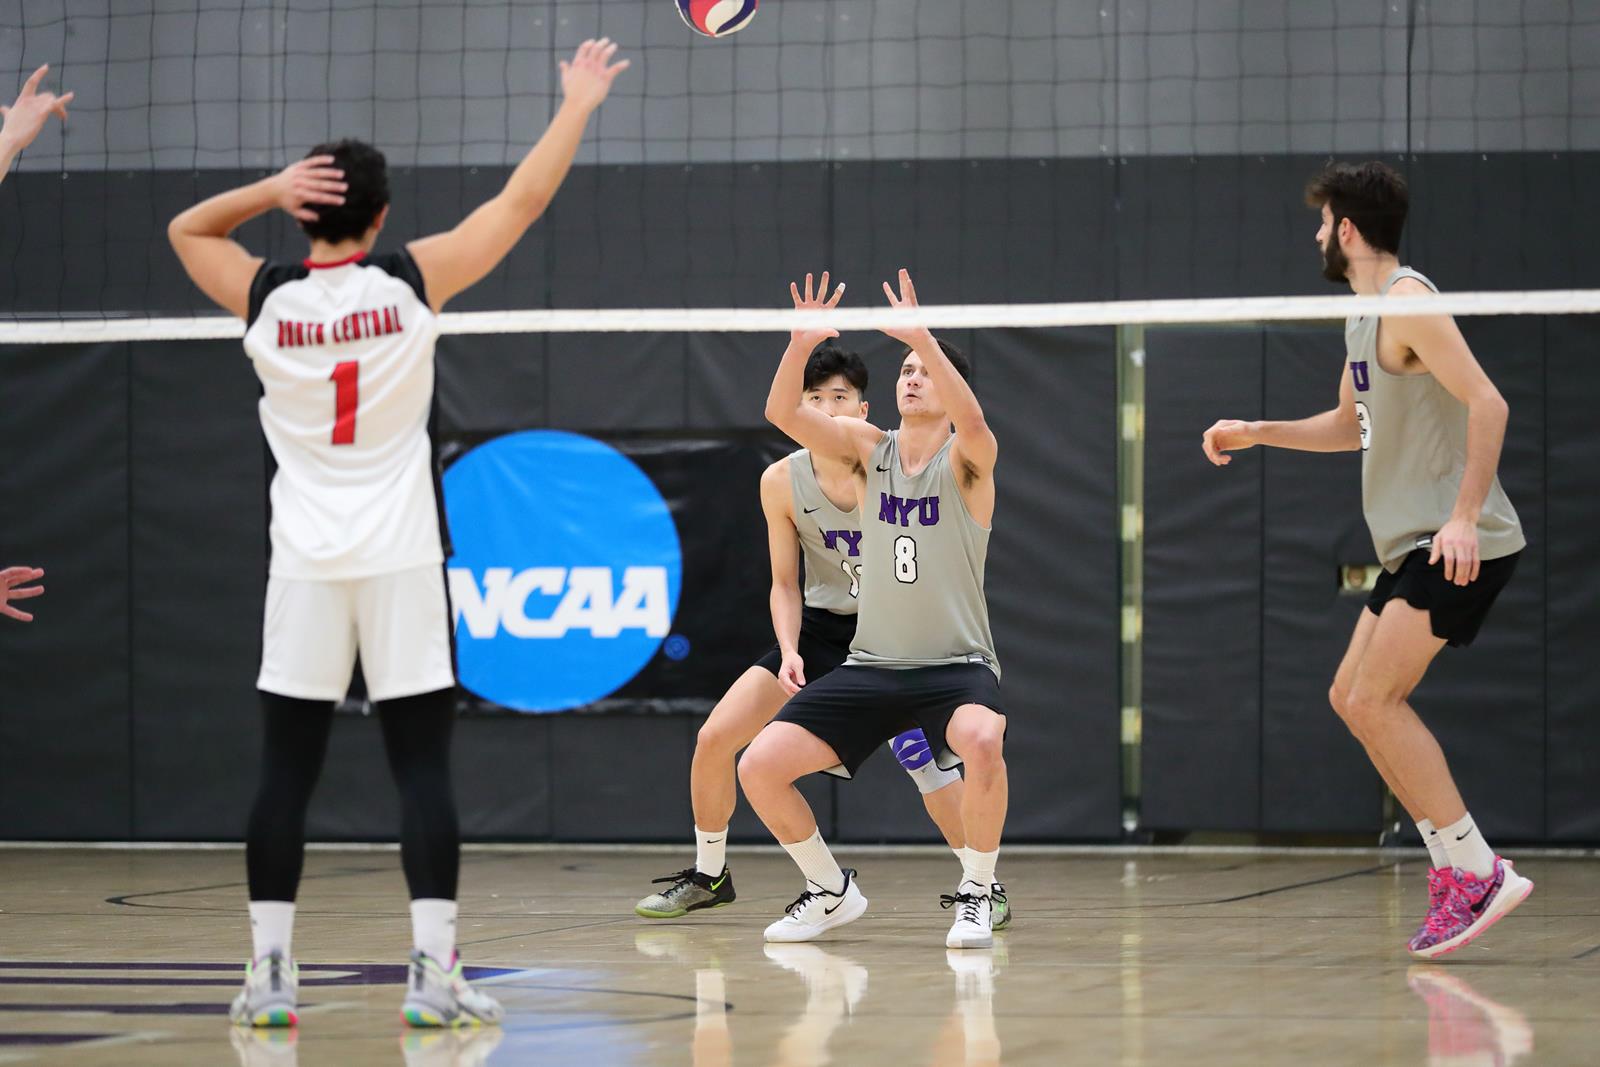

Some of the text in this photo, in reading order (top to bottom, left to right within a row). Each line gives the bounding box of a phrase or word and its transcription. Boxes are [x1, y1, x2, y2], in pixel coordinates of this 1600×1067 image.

[332, 306, 403, 343] CENTRAL
[329, 360, 359, 445] 1
[879, 492, 940, 527] NYU
[819, 526, 863, 557] NY
[894, 535, 918, 584] 8
[447, 566, 671, 639] NCAA
